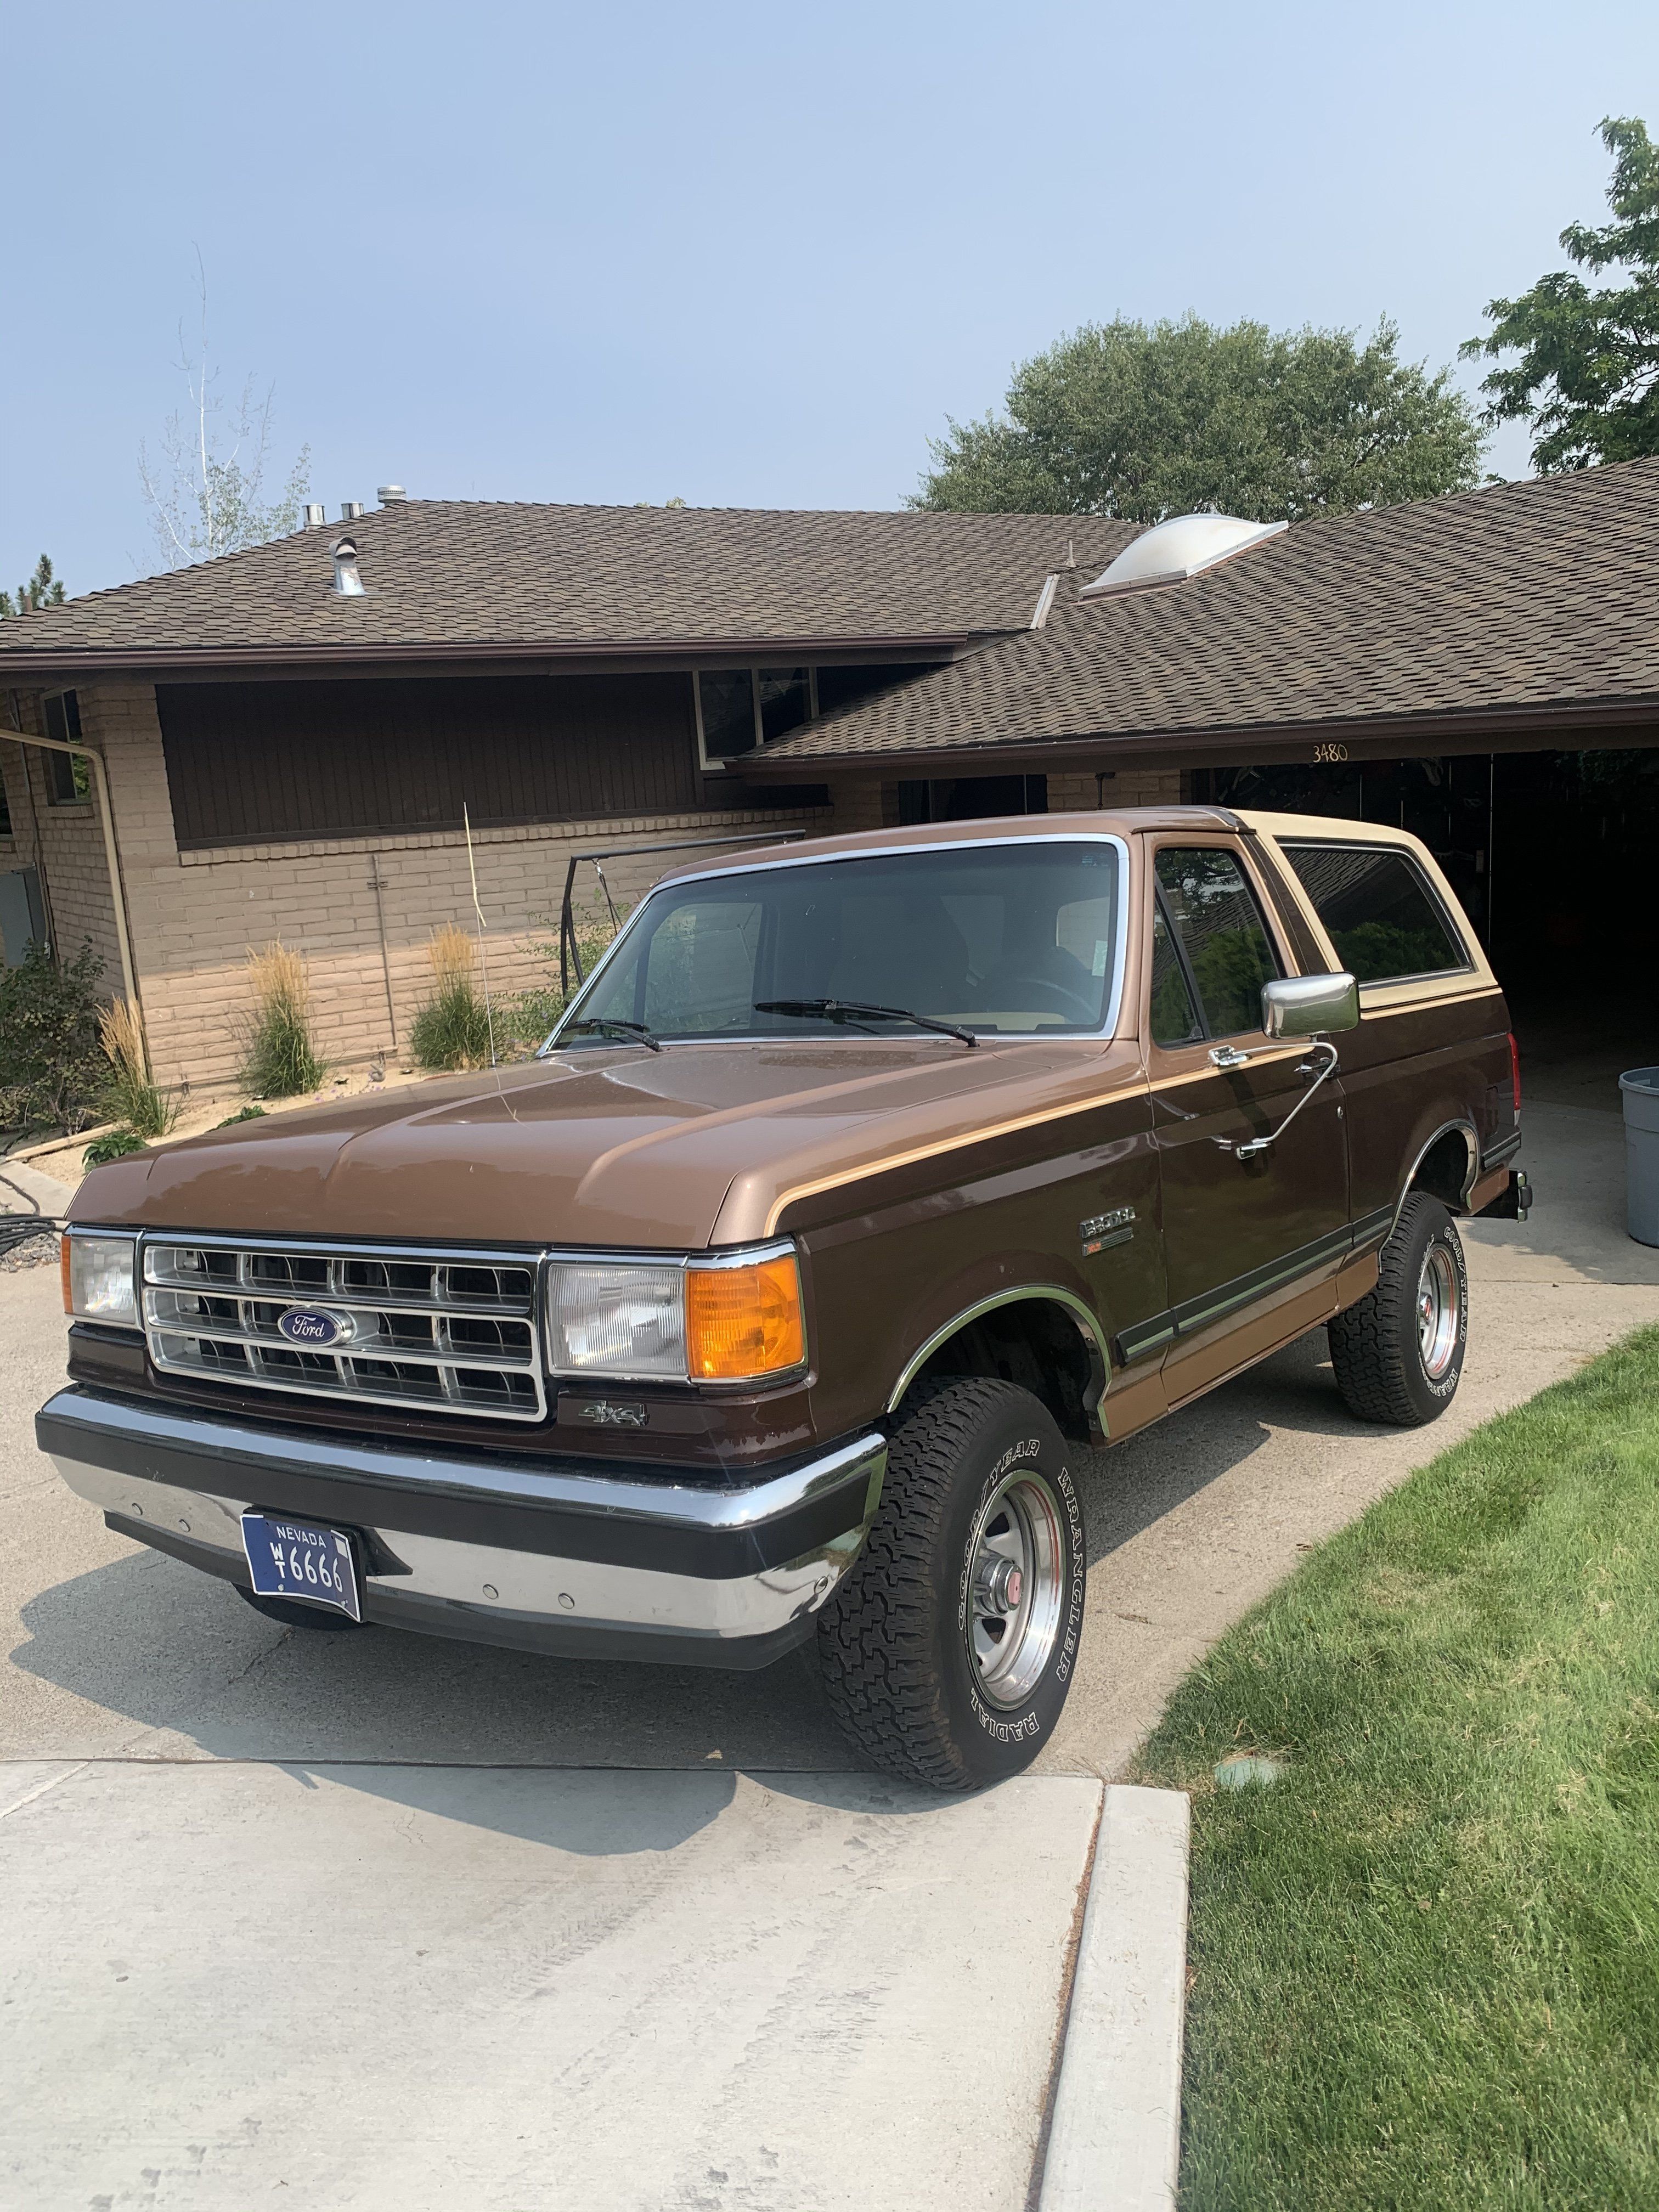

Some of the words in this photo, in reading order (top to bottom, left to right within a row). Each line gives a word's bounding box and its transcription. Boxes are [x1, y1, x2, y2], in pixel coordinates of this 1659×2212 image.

[1313, 743, 1348, 763] 3480
[292, 1315, 325, 1338] Ford
[276, 1526, 326, 1548] NEVADA
[958, 1440, 1040, 1630] GOODYEAR
[1057, 1467, 1083, 1682] WRANGLER
[971, 1687, 1040, 1742] RADIAL
